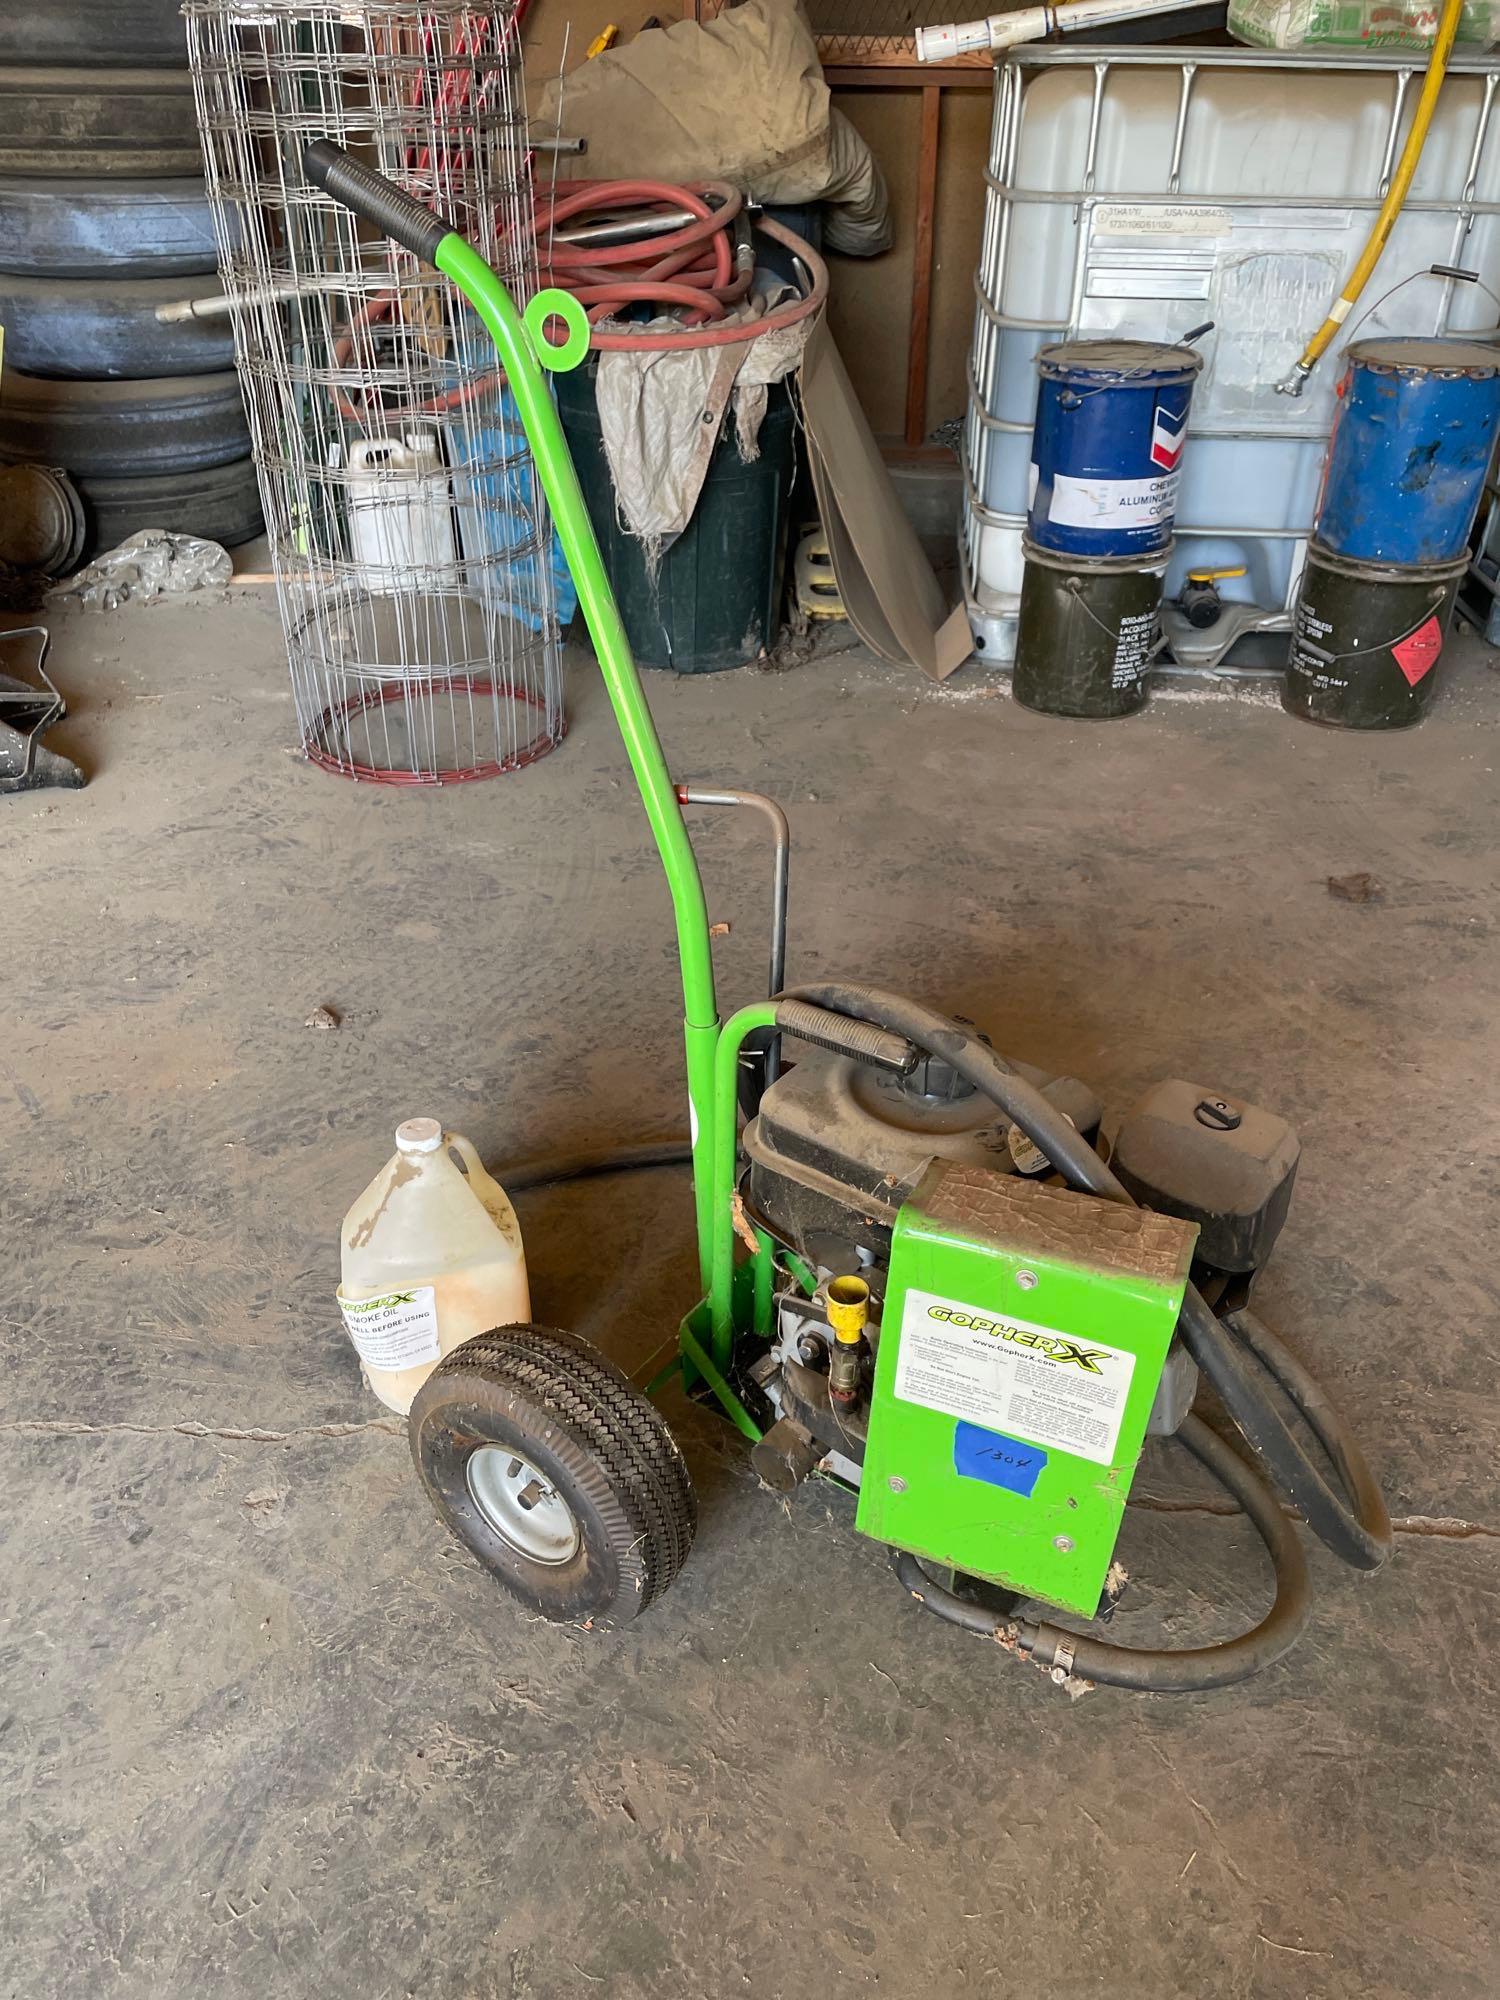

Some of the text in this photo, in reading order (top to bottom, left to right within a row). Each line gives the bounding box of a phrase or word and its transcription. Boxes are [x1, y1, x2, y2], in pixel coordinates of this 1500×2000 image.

[347, 1308, 399, 1324] SMOKE OIL
[371, 1319, 403, 1334] BEFORE
[404, 1311, 431, 1323] USING
[972, 1337, 1058, 1369] www.GopherX.com
[975, 1448, 1032, 1468] 1304
